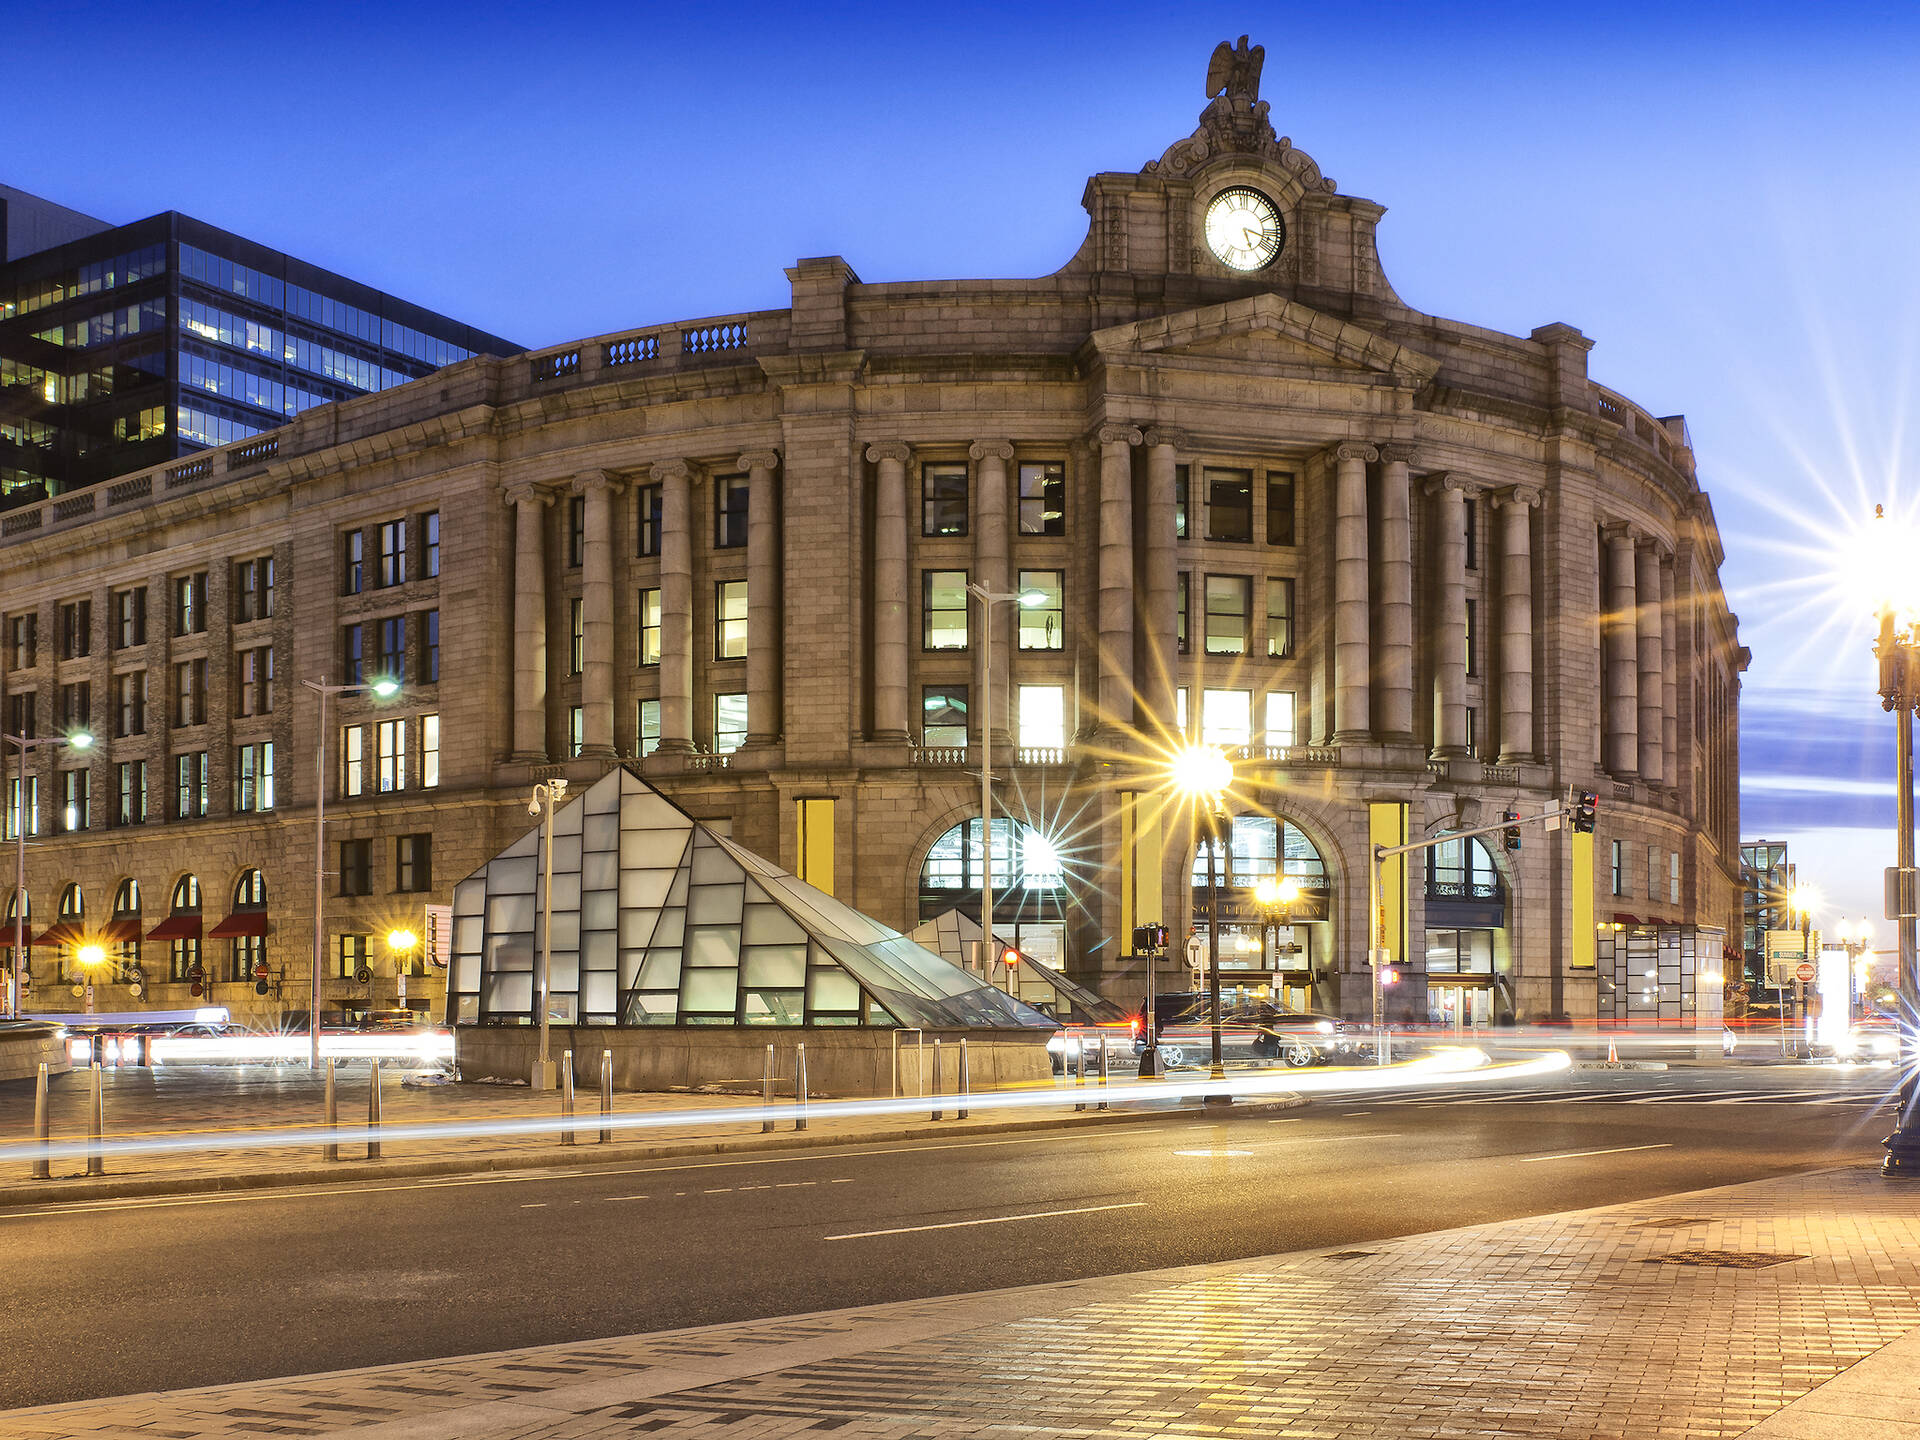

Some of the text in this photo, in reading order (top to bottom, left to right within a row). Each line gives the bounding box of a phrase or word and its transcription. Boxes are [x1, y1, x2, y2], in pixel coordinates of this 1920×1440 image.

[1192, 904, 1320, 915] SOTH SION
[1189, 944, 1200, 963] T
[360, 971, 368, 982] 2
